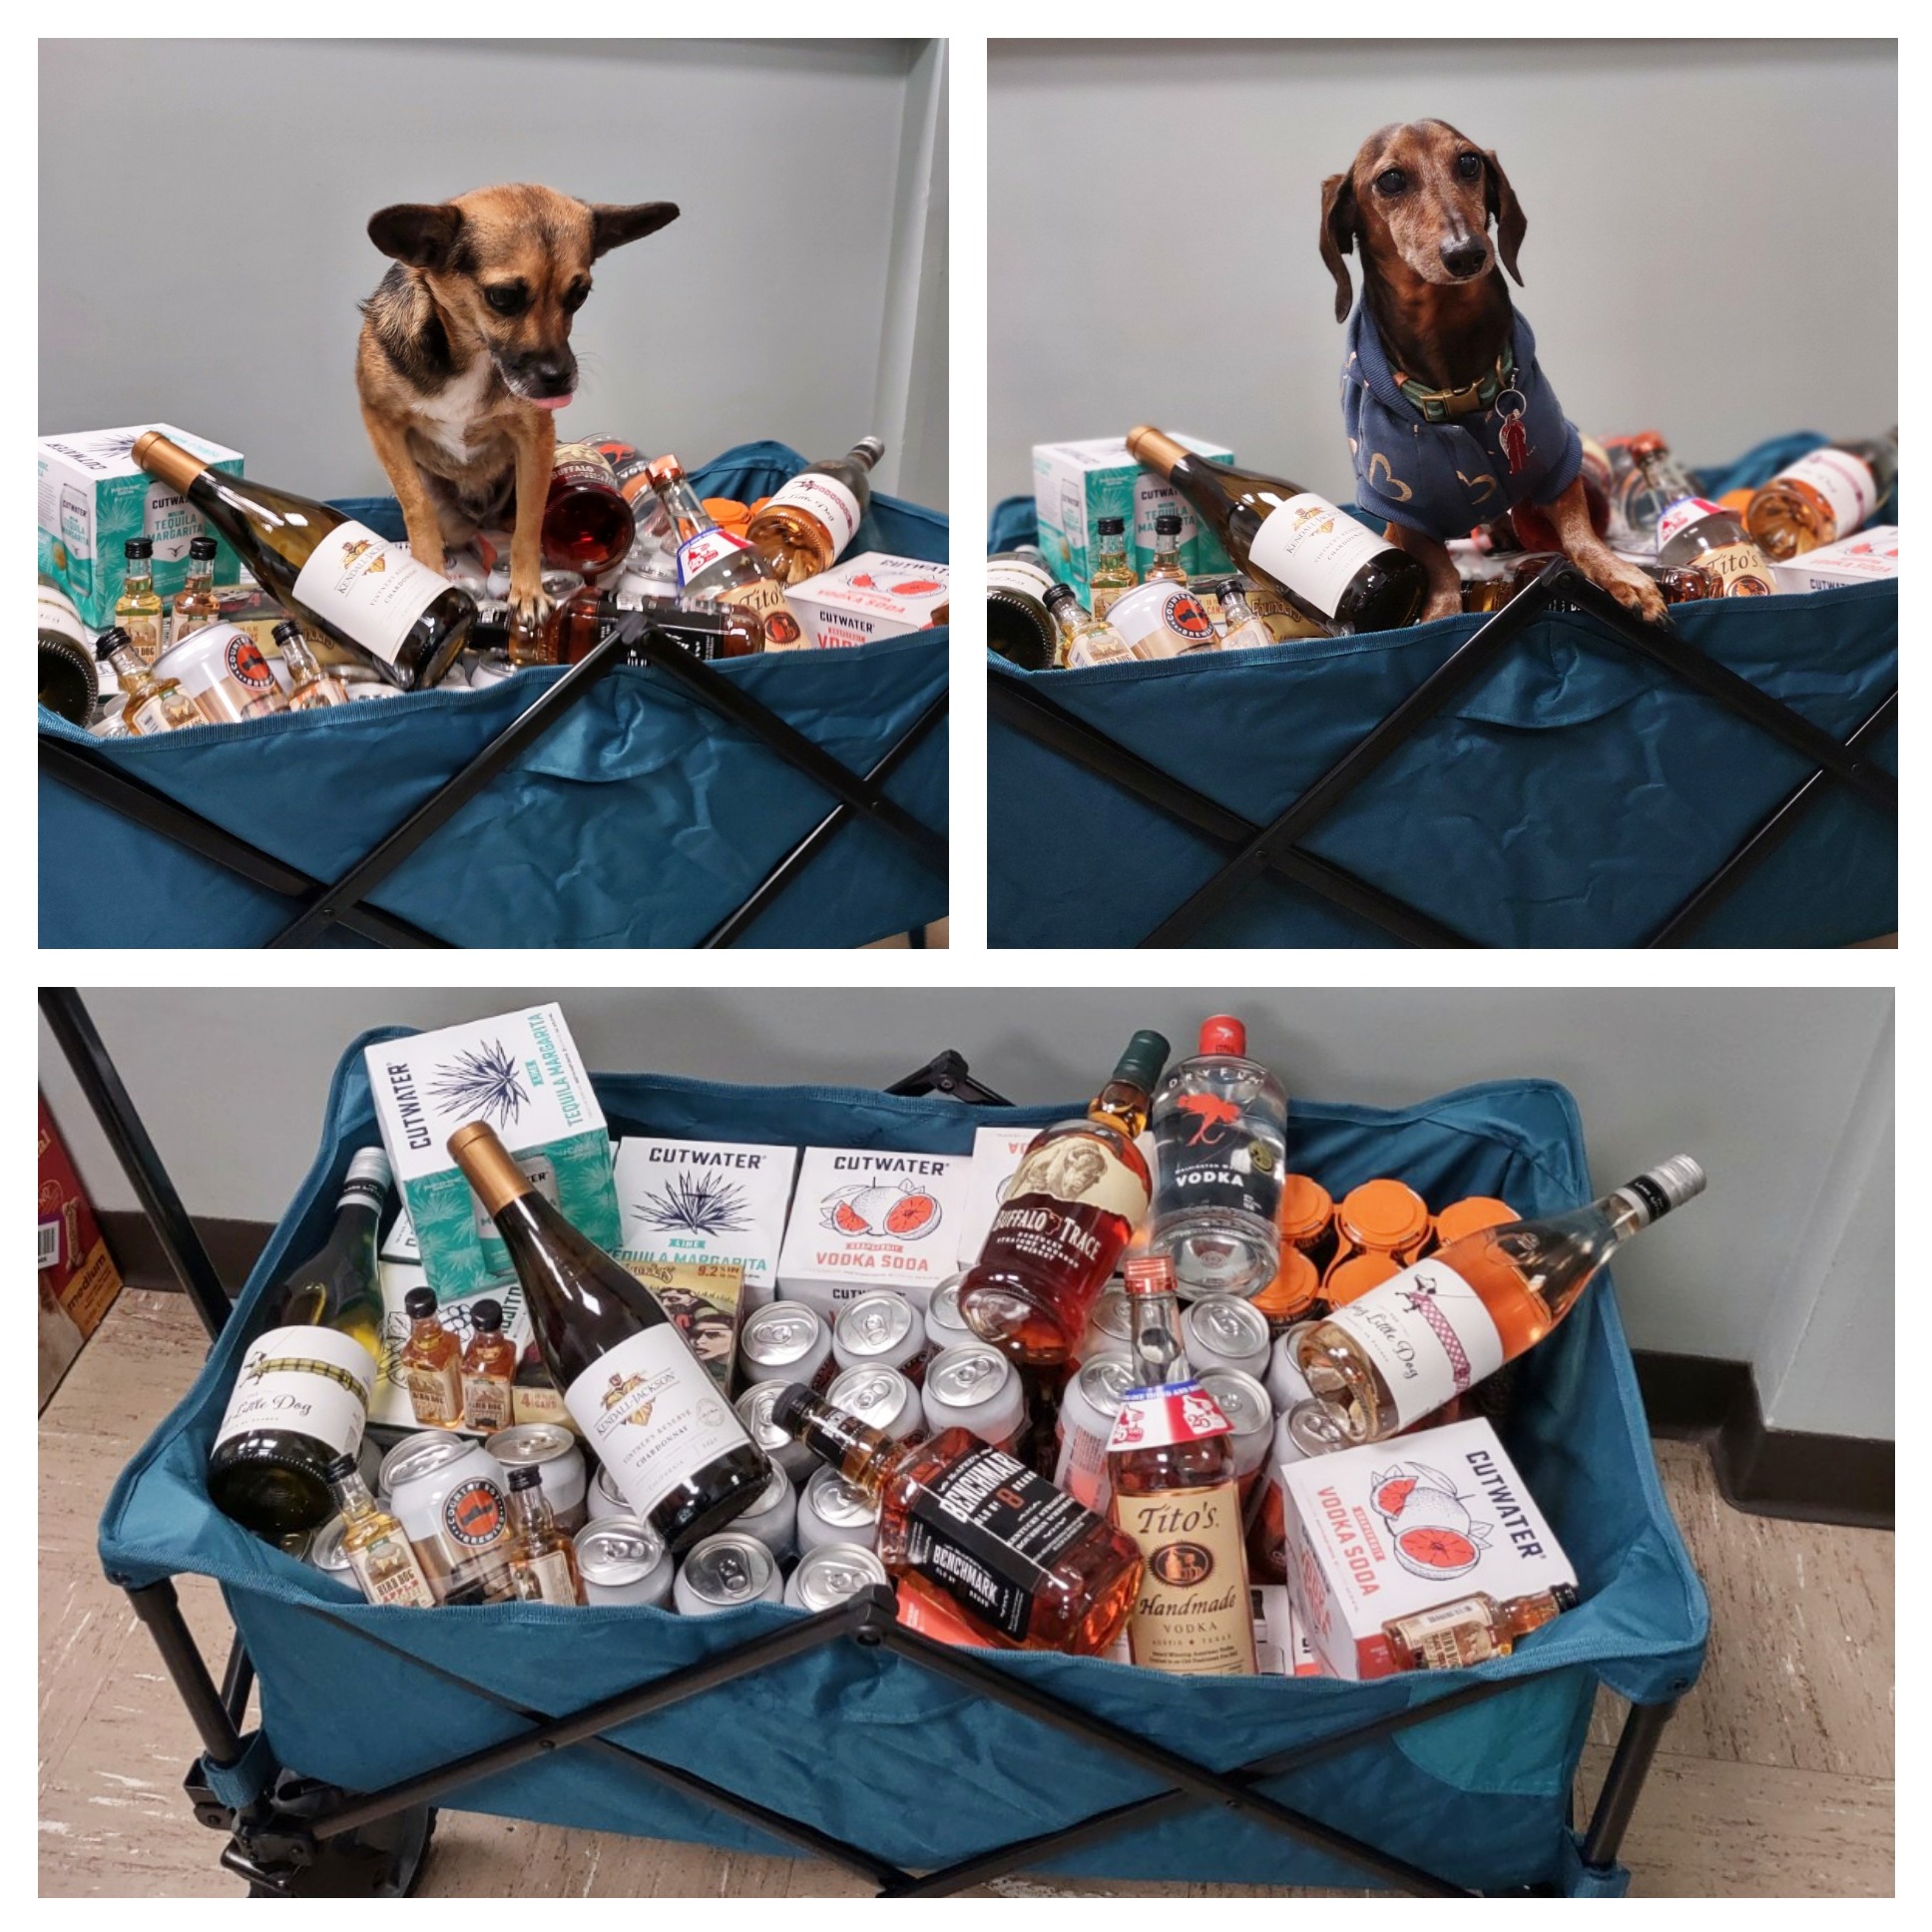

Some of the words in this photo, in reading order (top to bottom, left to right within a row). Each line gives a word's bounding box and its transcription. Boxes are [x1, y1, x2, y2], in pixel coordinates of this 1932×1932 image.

[152, 495, 190, 510] CUTWA
[155, 513, 198, 530] TEQUILA
[881, 559, 949, 577] CUTWAT
[819, 610, 874, 634] CUTWATER
[527, 1012, 566, 1077] MARGARITA
[387, 1063, 432, 1150] CUTWATER
[553, 1077, 584, 1127] TEQUILA
[650, 1147, 761, 1170] CUTWATER
[833, 1156, 945, 1177] CUTWATER
[1176, 1171, 1244, 1188] VODKA
[993, 1208, 1047, 1231] BUFFALO
[1059, 1216, 1102, 1260] TRACE
[699, 1265, 719, 1277] 9.2
[816, 1251, 875, 1267] VODKA
[881, 1254, 929, 1271] SODA
[67, 1253, 107, 1311] medium
[271, 1394, 313, 1416] Dog
[520, 1392, 532, 1408] 4
[596, 1371, 676, 1436] KENDALL-JACKSON
[636, 1424, 689, 1469] CHARDONNAY
[996, 1487, 1026, 1510] 8
[1466, 1450, 1544, 1559] CUTWATER
[1138, 1503, 1216, 1534] Tito's
[1317, 1486, 1357, 1545] VODKA
[1343, 1545, 1380, 1597] SODA
[933, 1544, 999, 1607] BENCHMARK
[1139, 1586, 1236, 1616] Handmade
[1163, 1622, 1217, 1634] VODKA
